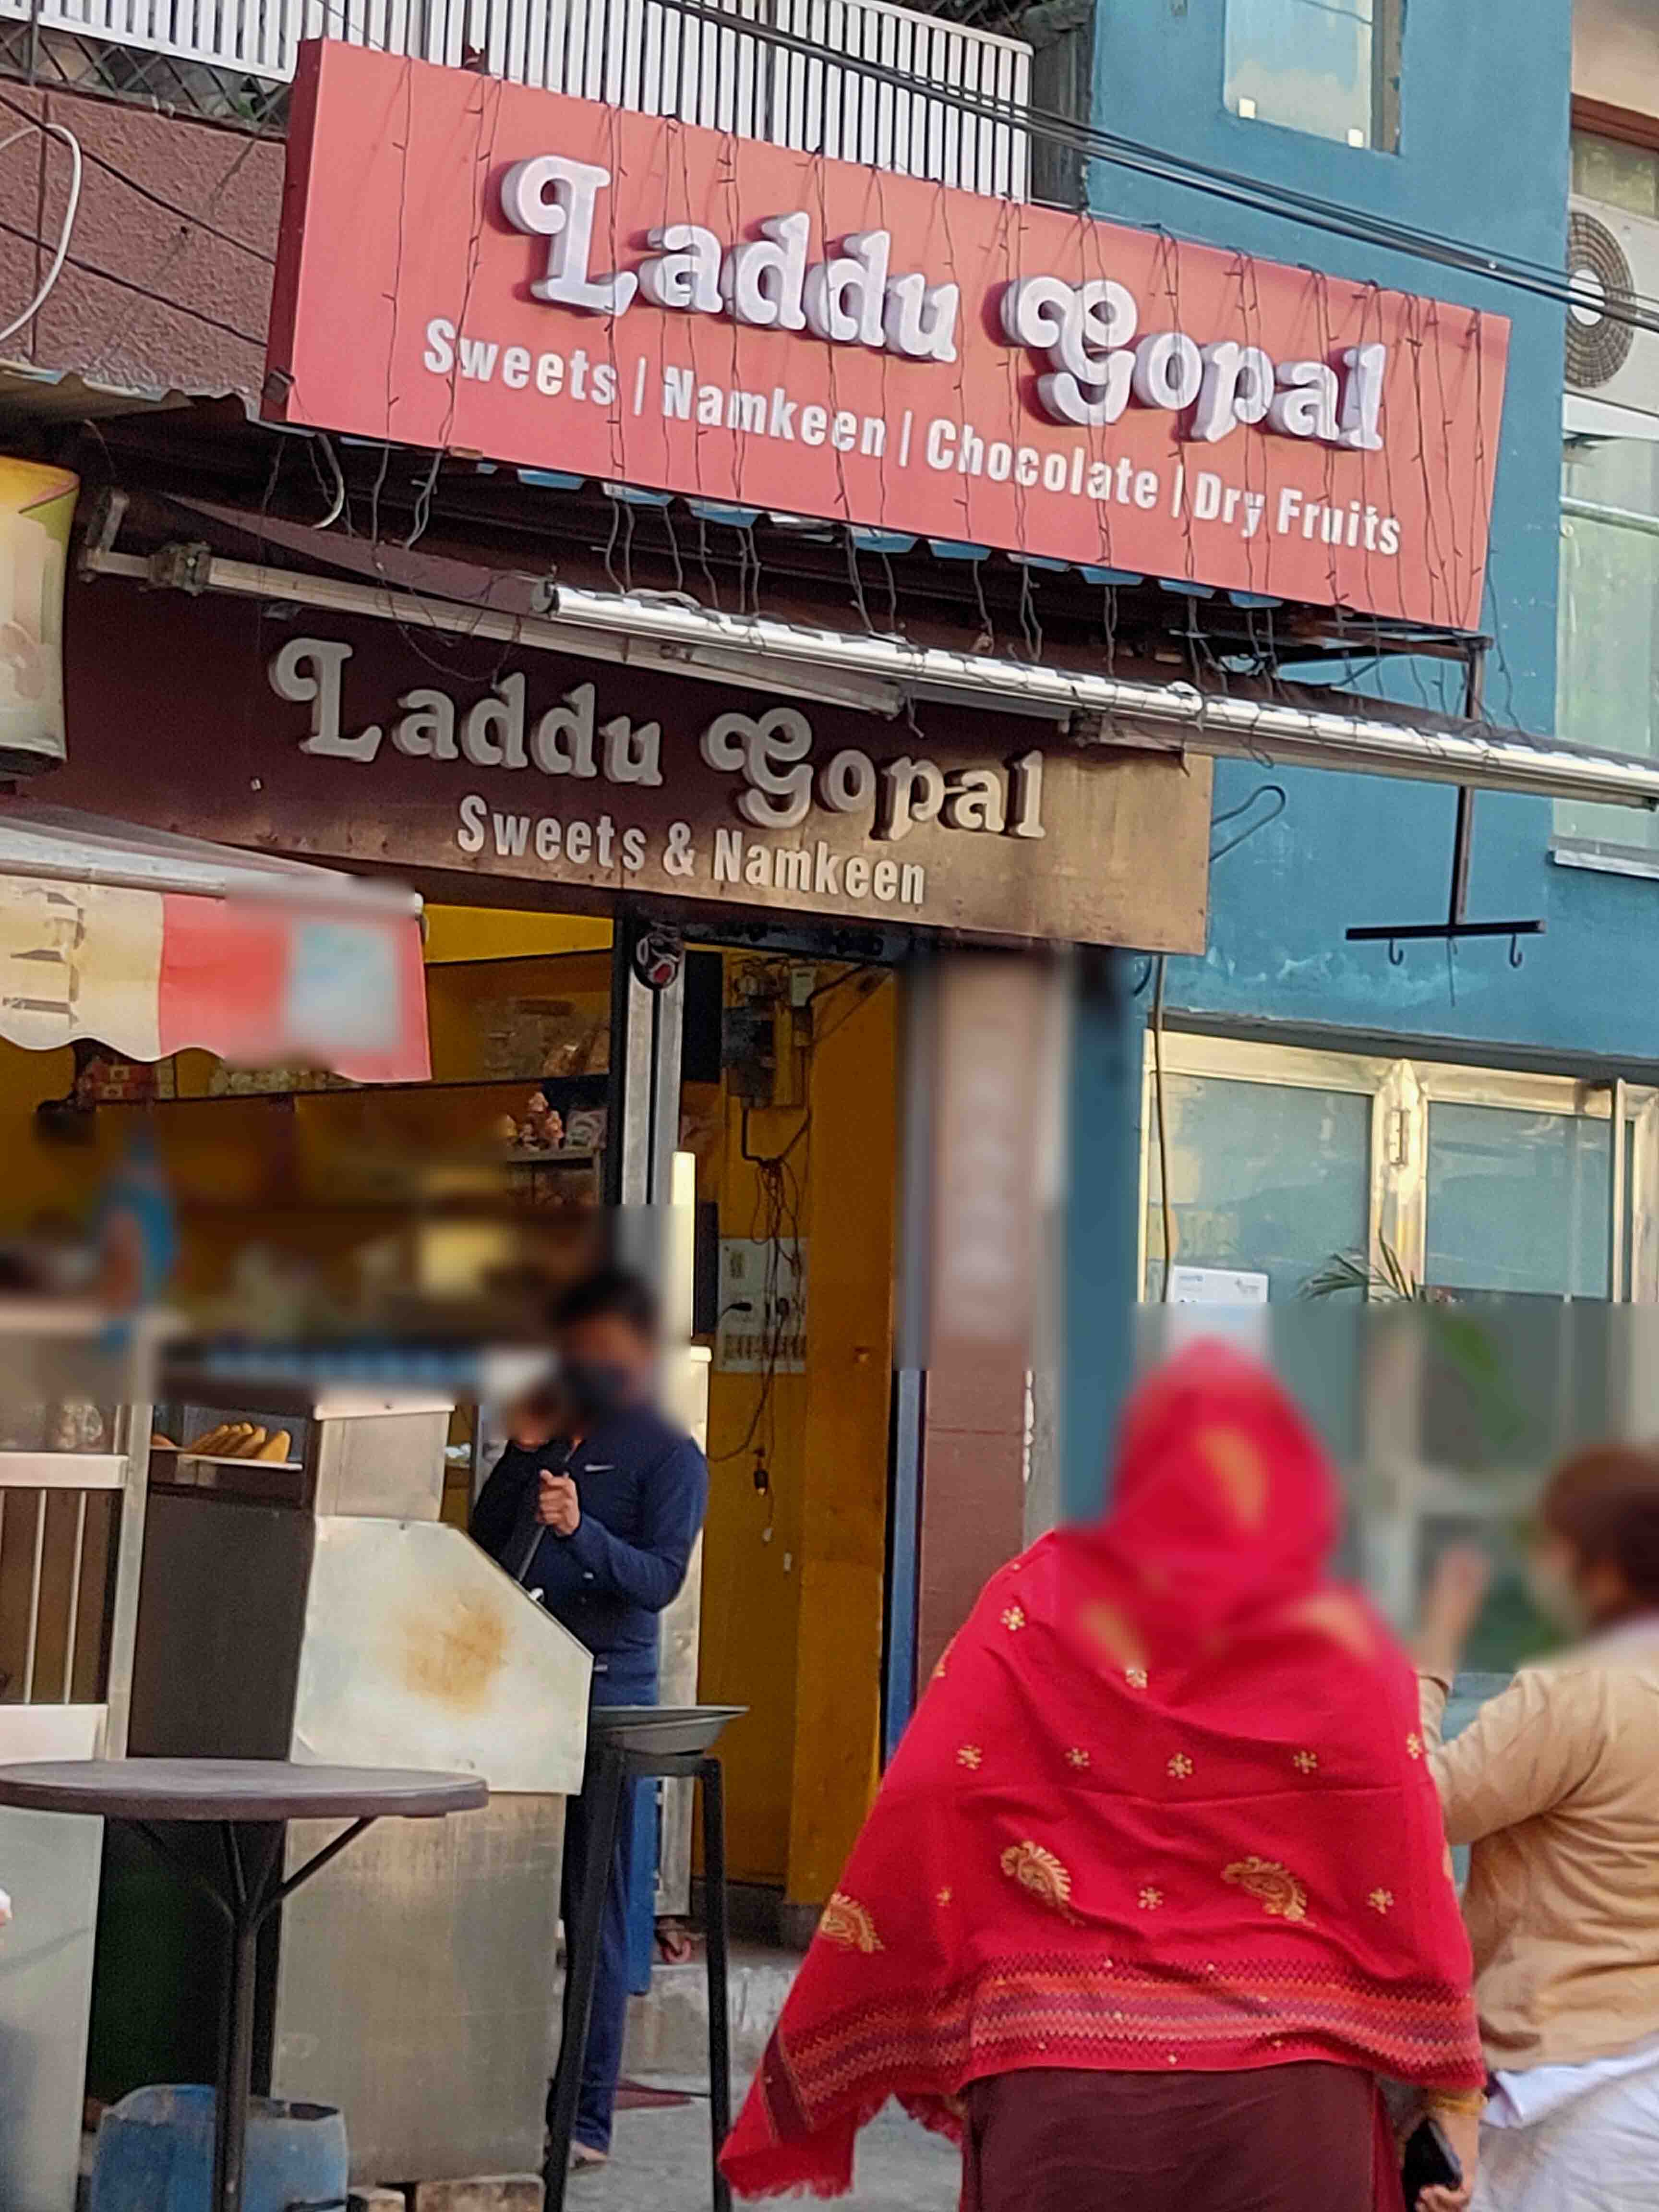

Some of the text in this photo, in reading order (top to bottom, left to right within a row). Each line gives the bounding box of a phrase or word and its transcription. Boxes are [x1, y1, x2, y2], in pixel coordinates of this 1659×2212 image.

[501, 155, 1386, 451] Laddu Gopal
[424, 318, 618, 405] Sweets
[663, 366, 885, 457] Namkeen
[926, 419, 1158, 509] Chocolate
[1194, 471, 1264, 537] Dry
[1277, 487, 1401, 556] Fruits
[268, 637, 1046, 841] Laddu Gopal
[457, 794, 926, 904] Sweets & Namkeen
